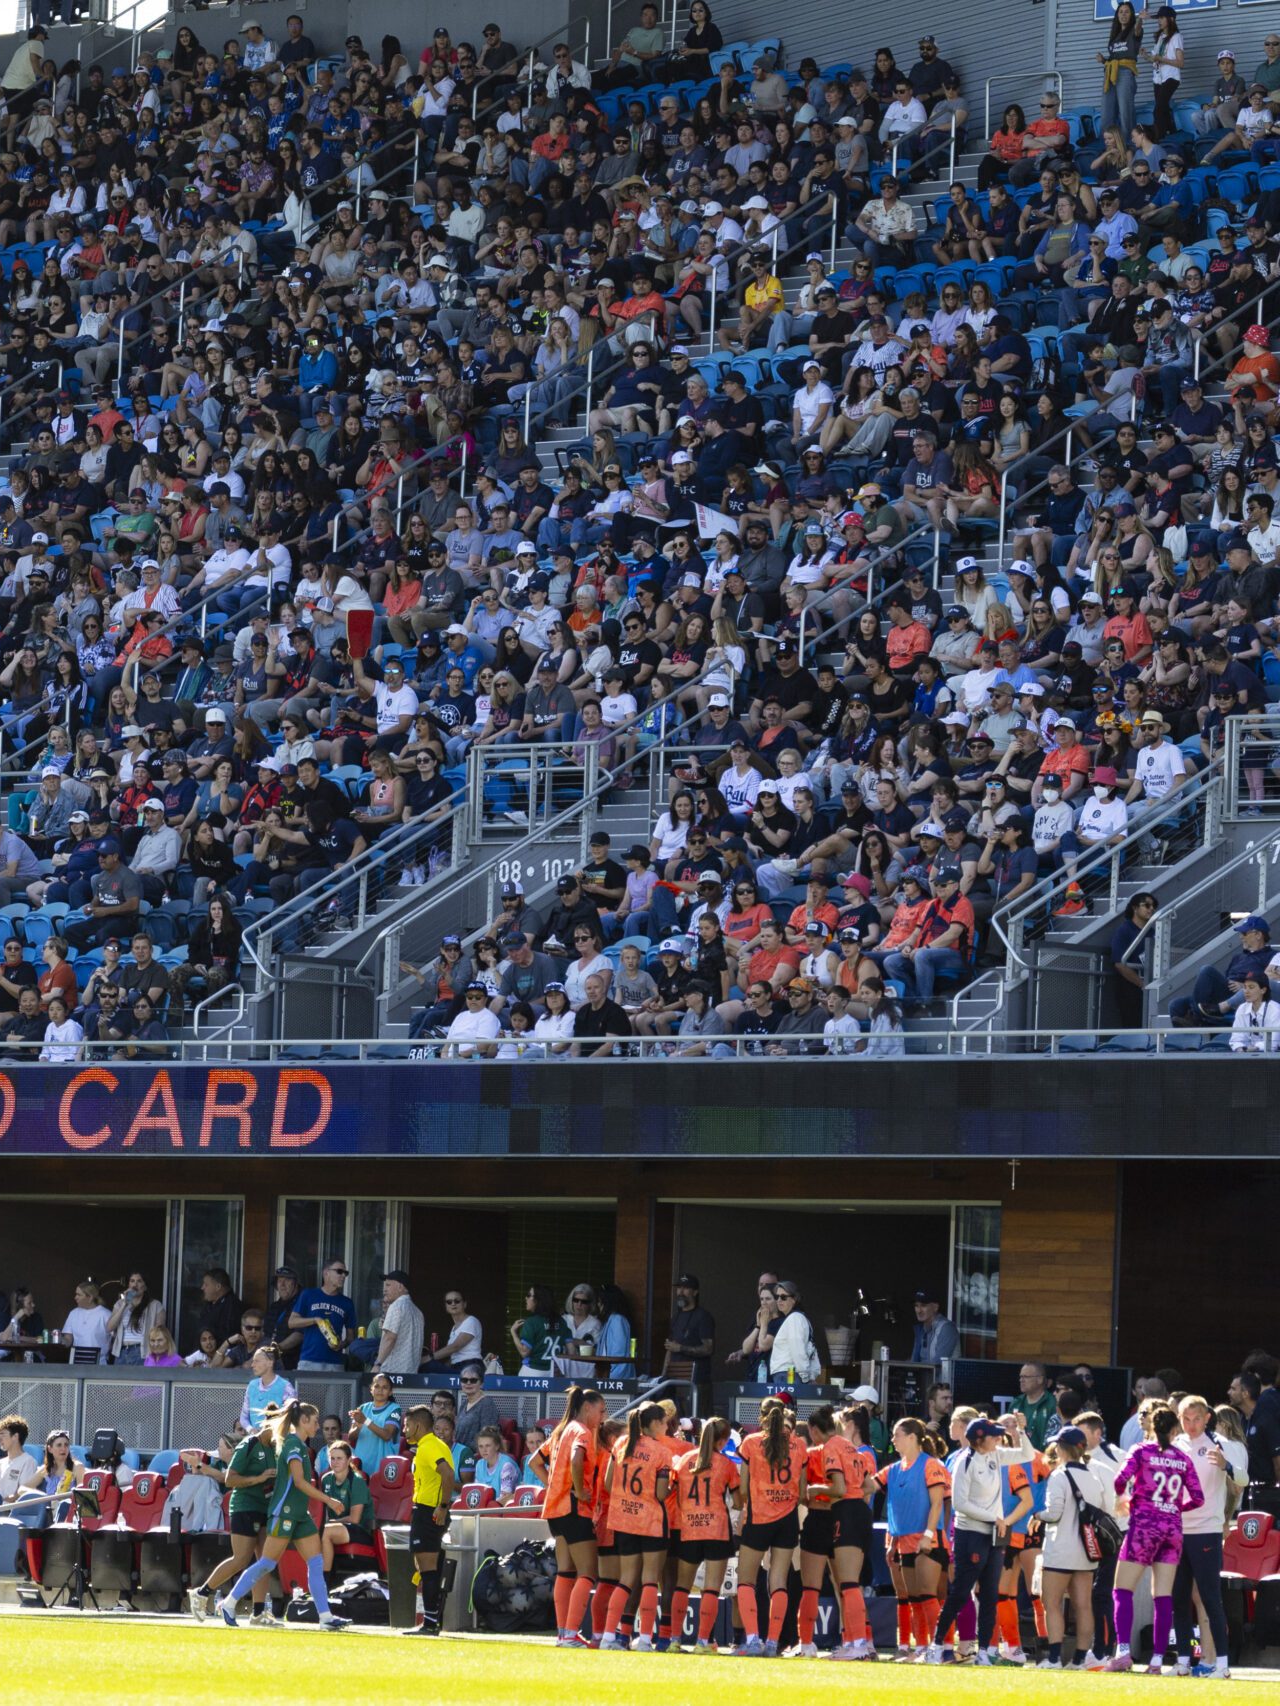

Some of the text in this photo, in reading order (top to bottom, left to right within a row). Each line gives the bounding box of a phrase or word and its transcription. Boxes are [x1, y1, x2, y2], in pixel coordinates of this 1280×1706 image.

[725, 785, 747, 805] Bay
[494, 860, 521, 882] 08
[622, 984, 643, 1000] Bay
[58, 1067, 333, 1149] CARD
[311, 1302, 345, 1317] GOLDEN STATE
[544, 1336, 560, 1359] 26
[523, 1380, 549, 1388] TIXR
[596, 1381, 623, 1390] TIXR
[622, 1463, 643, 1495] 16
[769, 1457, 792, 1486] 18
[687, 1477, 711, 1507] 41
[1151, 1471, 1183, 1503] 29
[686, 1513, 715, 1521] TRADER
[690, 1520, 710, 1528] JOE'S
